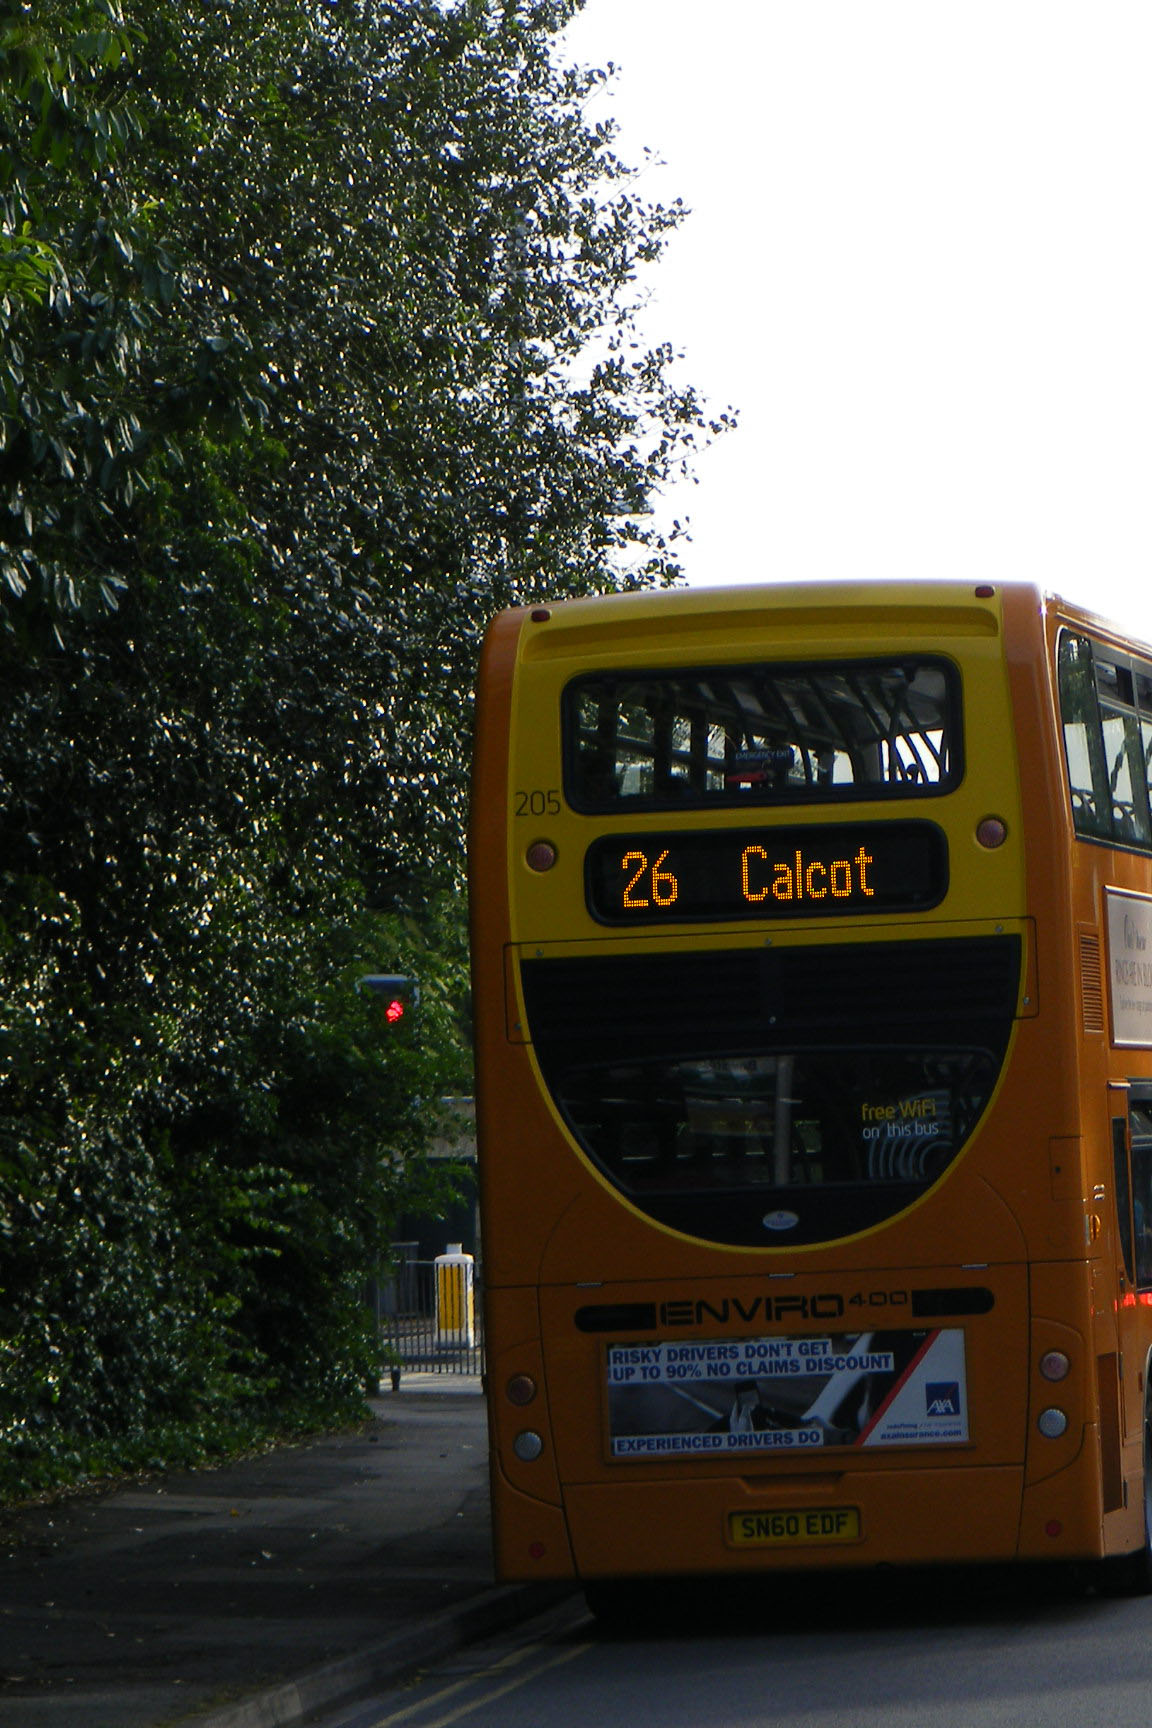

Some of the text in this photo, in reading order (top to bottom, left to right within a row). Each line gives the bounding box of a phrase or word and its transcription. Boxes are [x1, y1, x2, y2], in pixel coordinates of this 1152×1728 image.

[514, 790, 561, 816] 205
[621, 844, 876, 908] 26 Calcot
[861, 1098, 937, 1121] free WiFi
[862, 1120, 940, 1140] on this bus
[660, 1290, 908, 1327] ENVIRO 400
[612, 1340, 829, 1365] RISKY DRIVERS DON'T GET
[613, 1353, 892, 1382] UP TO 90% NO CLAIMS DISCOUNT
[926, 1399, 956, 1414] AXA
[616, 1430, 821, 1452] EXPERIENCED DRIVERS DO
[880, 1429, 962, 1441] axainsurance.com
[742, 1511, 849, 1537] SN60 EDF
